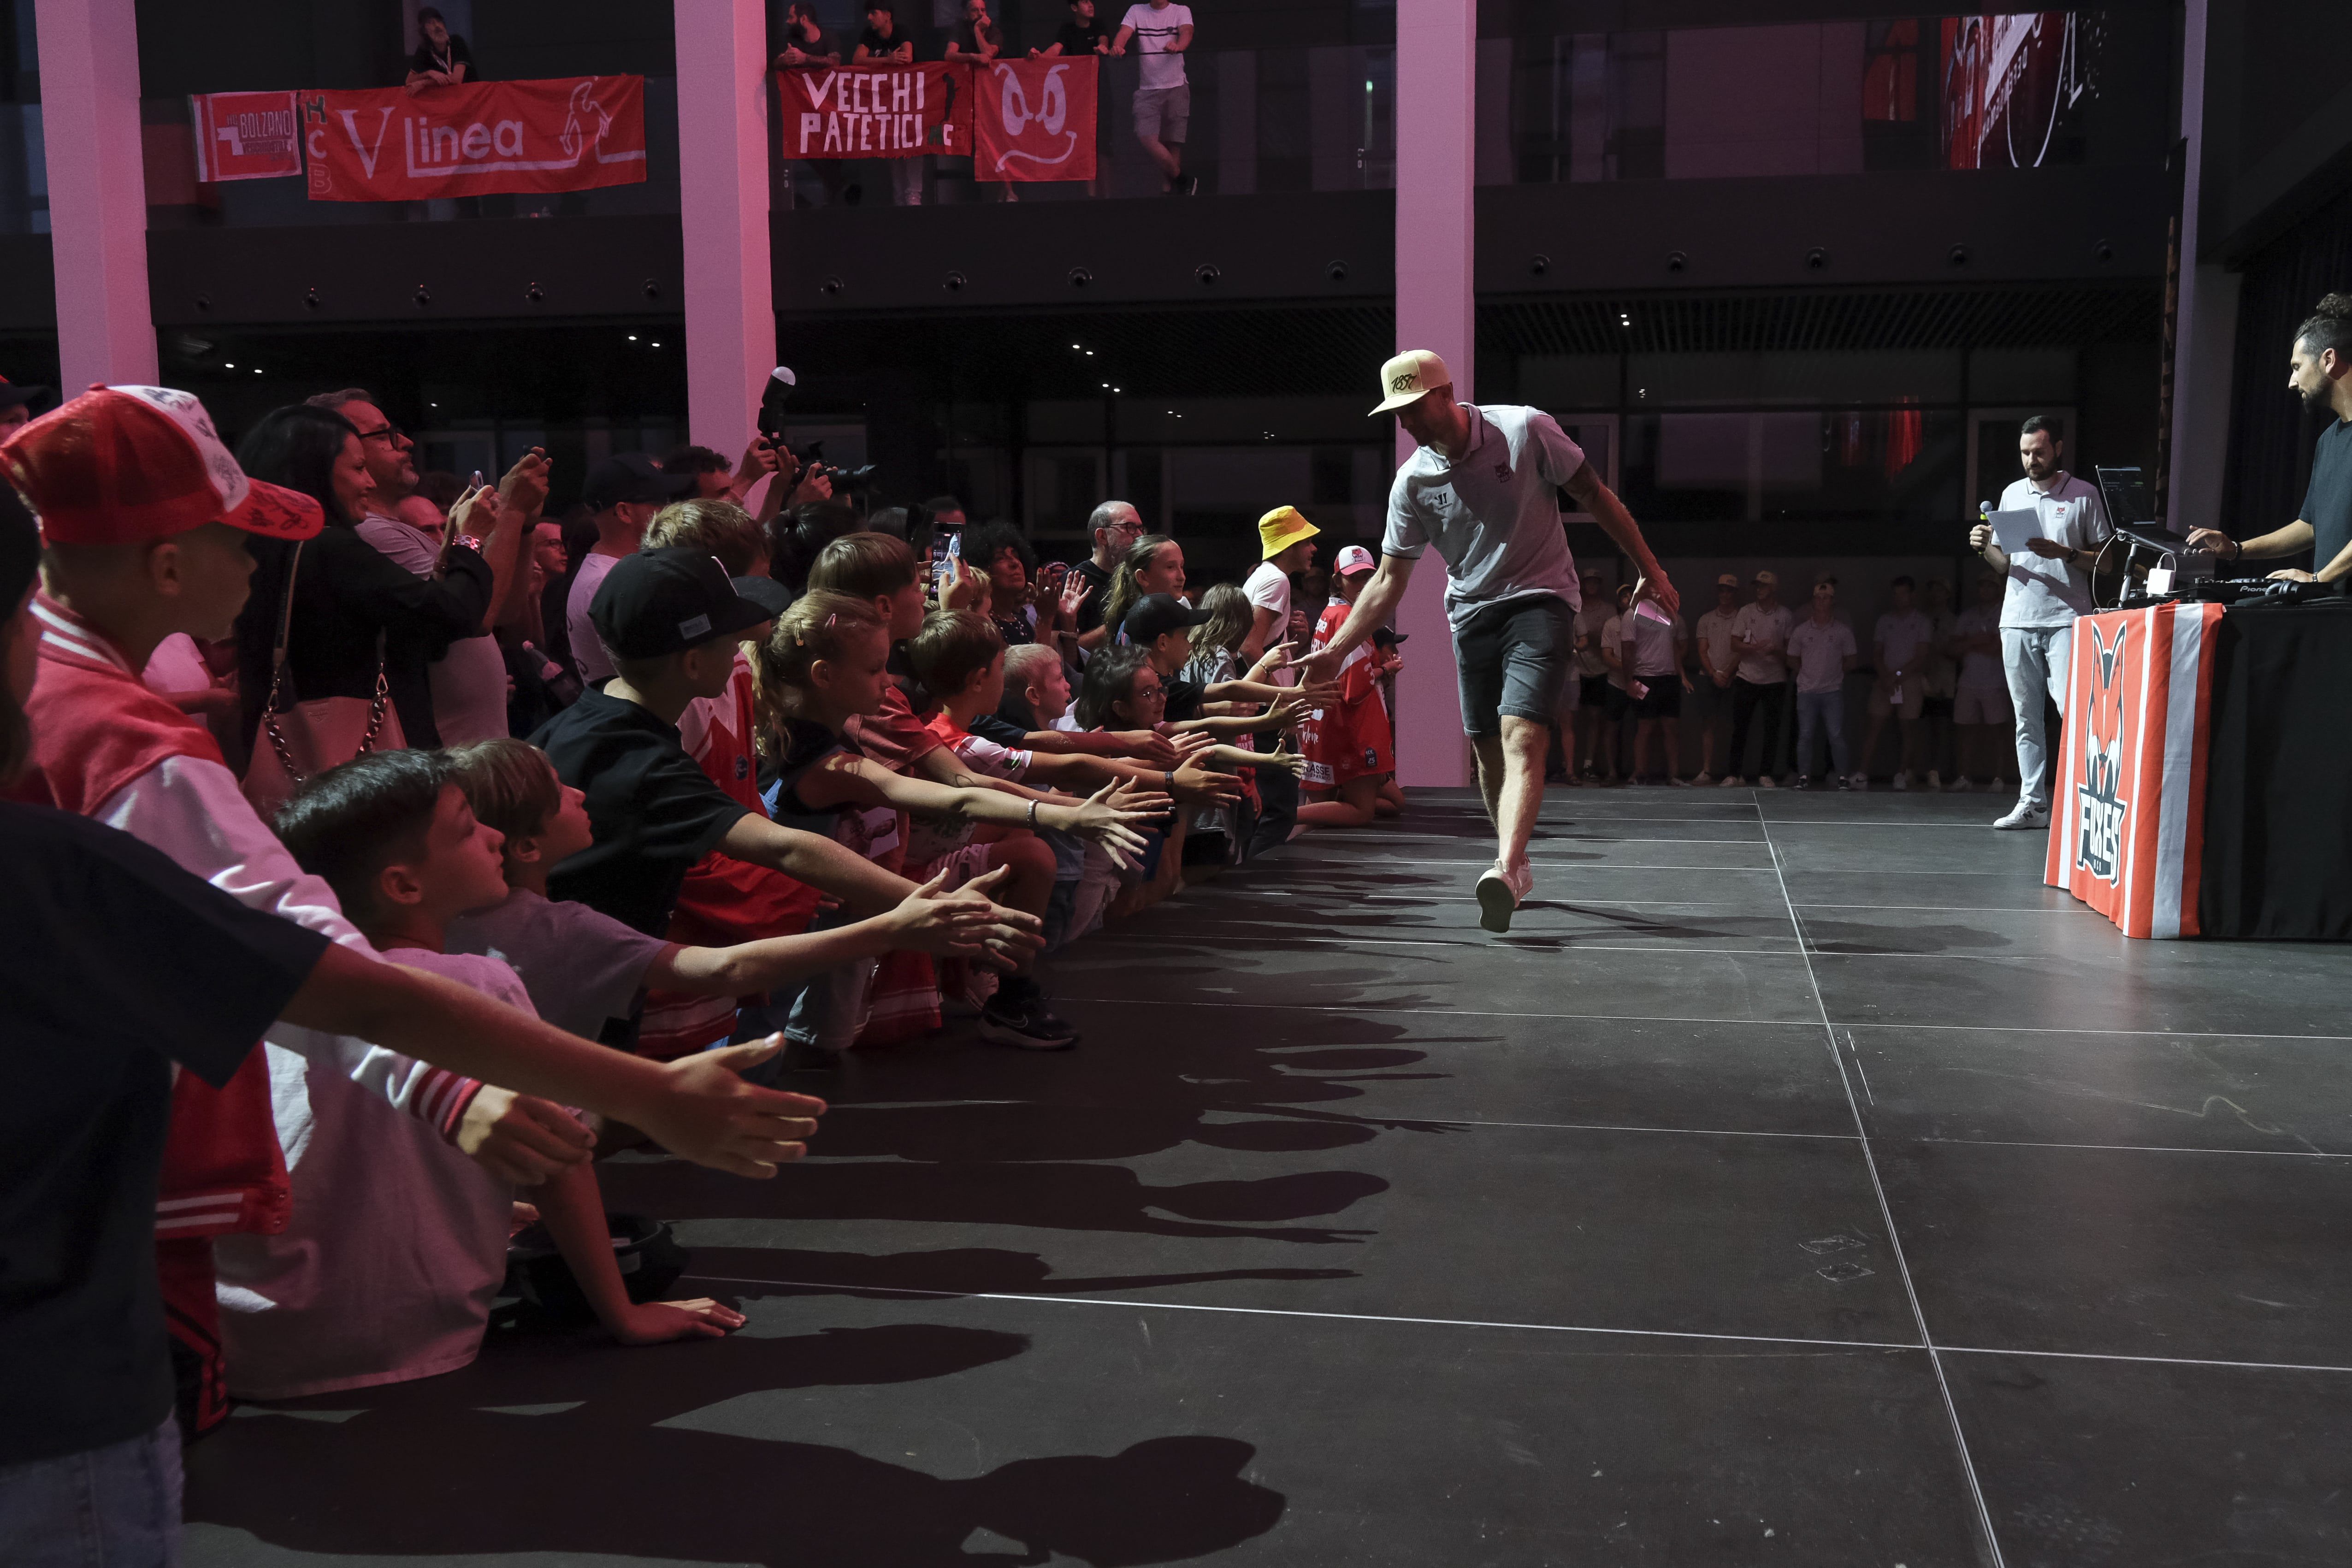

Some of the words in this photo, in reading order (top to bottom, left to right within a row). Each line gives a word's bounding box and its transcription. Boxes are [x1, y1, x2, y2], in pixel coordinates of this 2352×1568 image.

[802, 71, 924, 113] VECCHI
[240, 110, 291, 138] BOLZANO
[335, 107, 396, 179] V
[404, 117, 523, 178] Linea
[800, 112, 923, 154] PATETICI
[2078, 792, 2122, 880] FOXES
